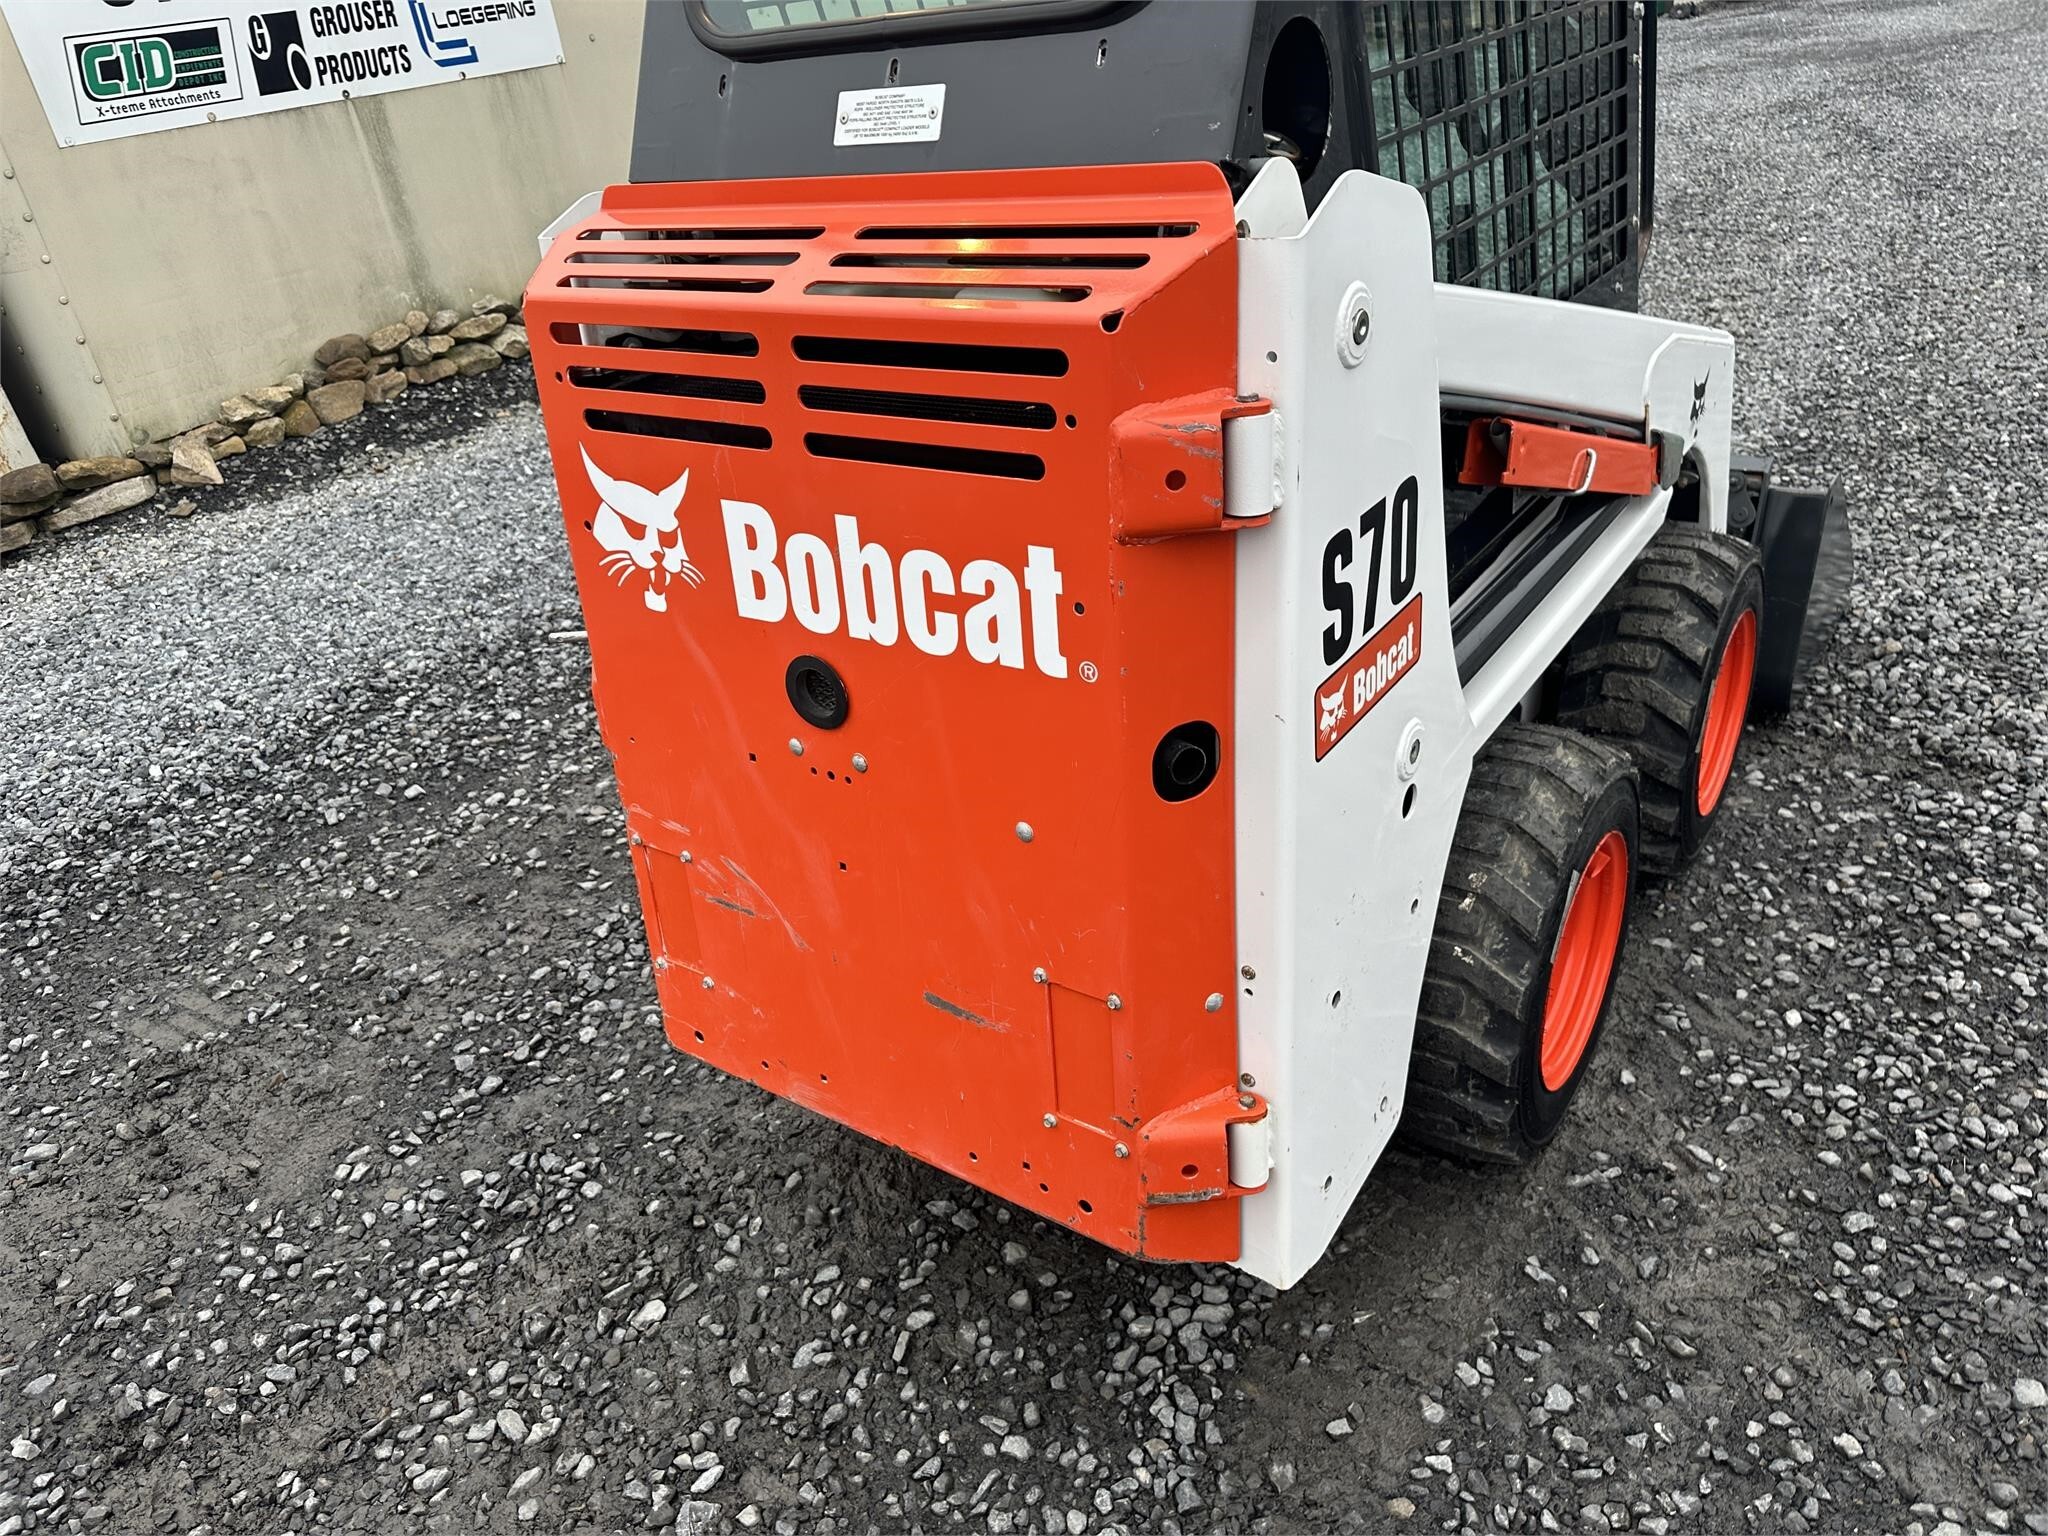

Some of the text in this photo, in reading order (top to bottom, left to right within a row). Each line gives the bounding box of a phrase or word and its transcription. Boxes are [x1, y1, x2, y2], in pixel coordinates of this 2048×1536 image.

[310, 0, 399, 38] GROUSER
[432, 0, 536, 29] LOEGERING
[83, 40, 173, 96] CID
[174, 46, 220, 59] CONSTRUCTION
[314, 44, 412, 87] PRODUCTS
[178, 73, 224, 87] DEPOT INC
[96, 89, 221, 117] X-treme Attachments
[720, 499, 1068, 679] Bobcat
[1322, 475, 1419, 666] S70
[1353, 621, 1415, 716] Bobcat
